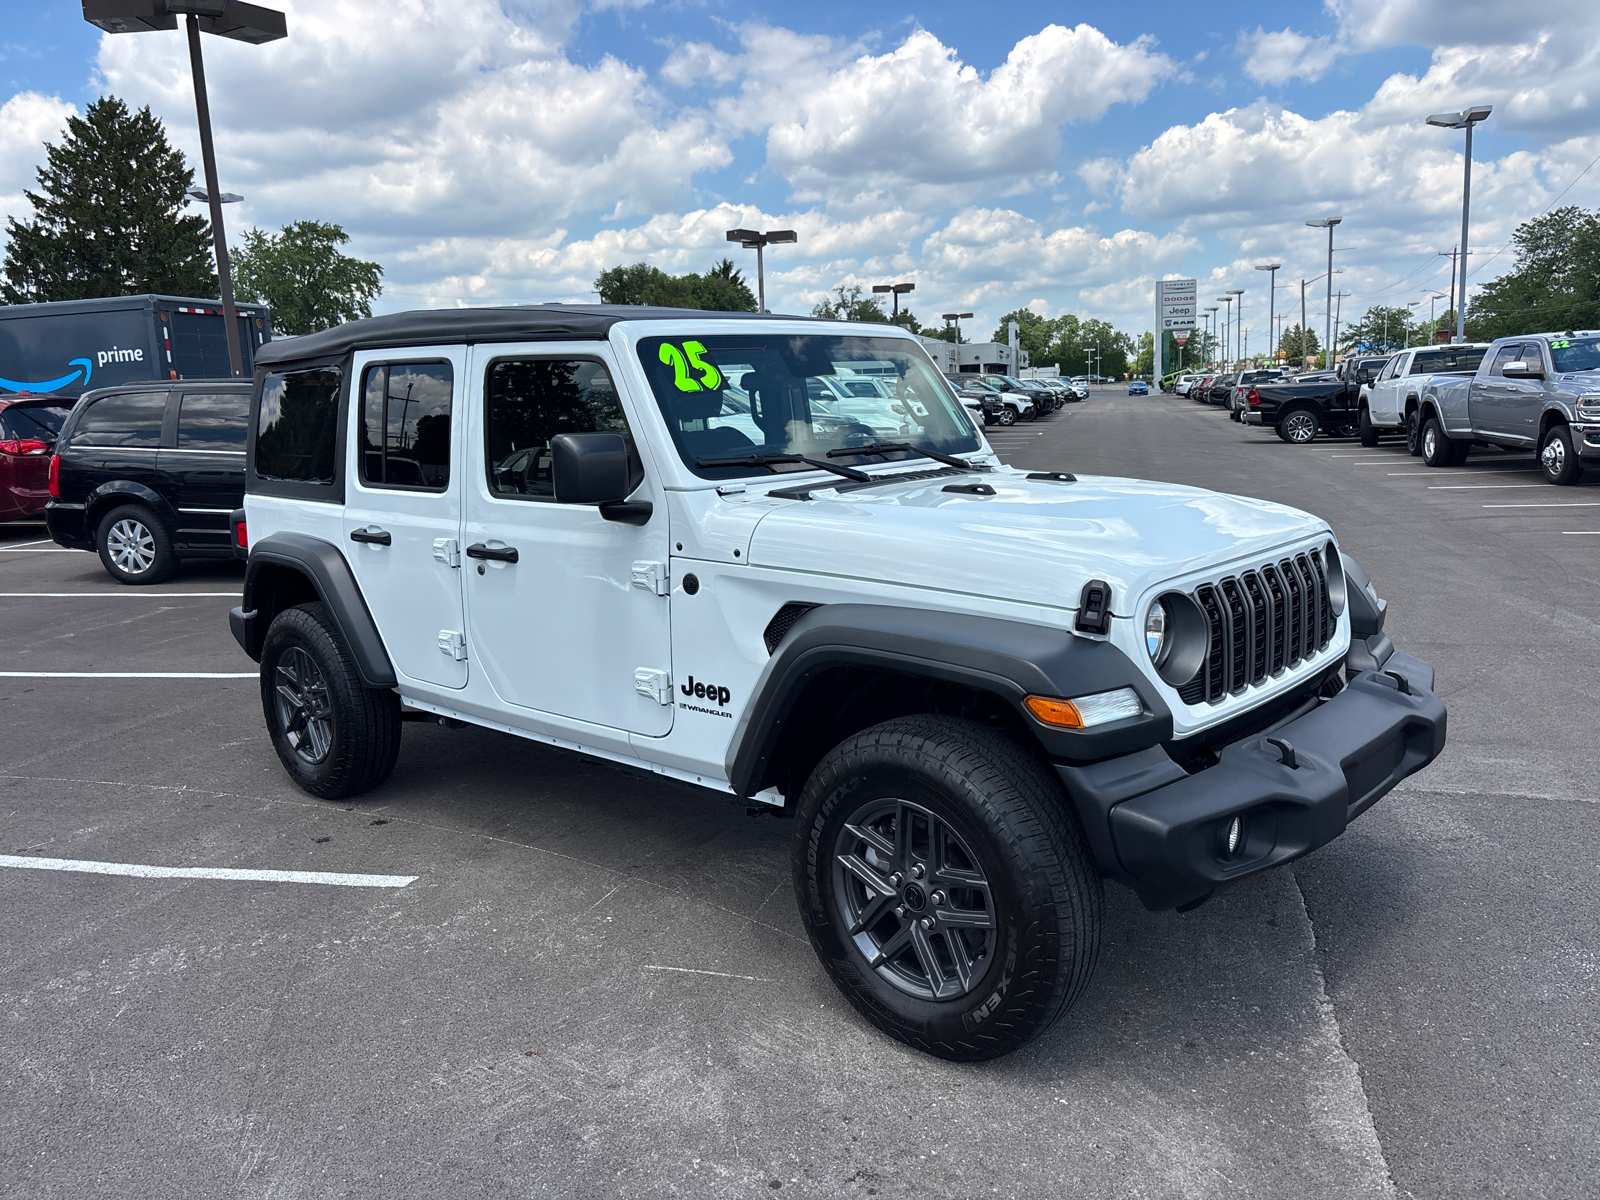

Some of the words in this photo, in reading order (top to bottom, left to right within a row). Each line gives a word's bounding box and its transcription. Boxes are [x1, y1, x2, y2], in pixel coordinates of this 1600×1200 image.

[1169, 307, 1190, 315] Jeep
[1551, 340, 1570, 349] 22
[97, 346, 144, 368] prime
[658, 340, 723, 393] 25
[680, 675, 731, 707] Jeep
[686, 704, 733, 719] WRANGLER
[972, 926, 1019, 1024] NEXEN
